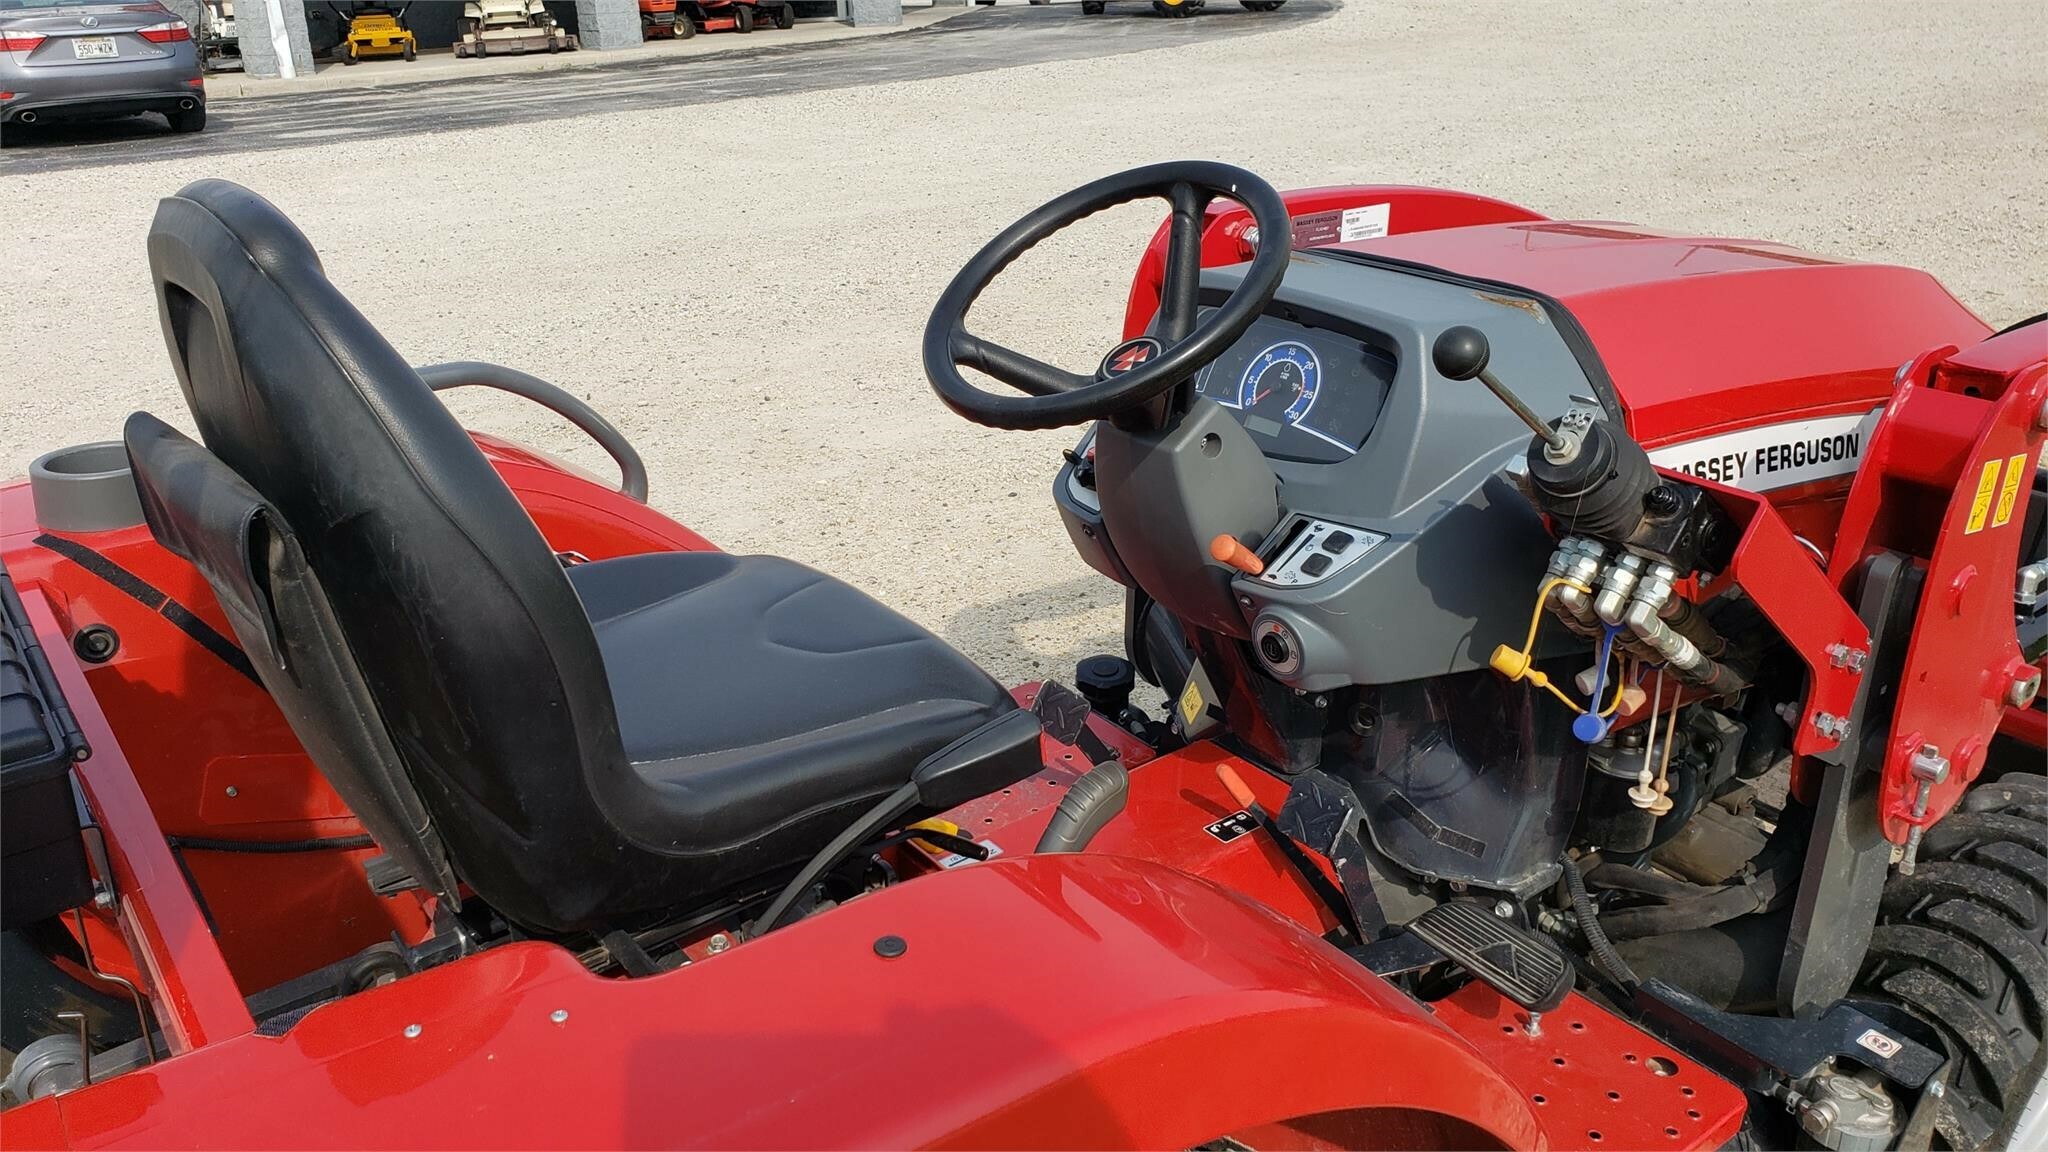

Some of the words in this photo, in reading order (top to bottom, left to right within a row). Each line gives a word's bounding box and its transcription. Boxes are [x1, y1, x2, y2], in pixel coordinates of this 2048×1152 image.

[1288, 348, 1296, 356] 15
[1264, 353, 1272, 362] 10
[1304, 361, 1314, 369] 20
[1303, 391, 1313, 399] 25
[1245, 398, 1252, 406] 0
[1288, 411, 1299, 420] 30
[1671, 451, 1748, 482] SSEY
[1755, 433, 1859, 475] FERGUSON
